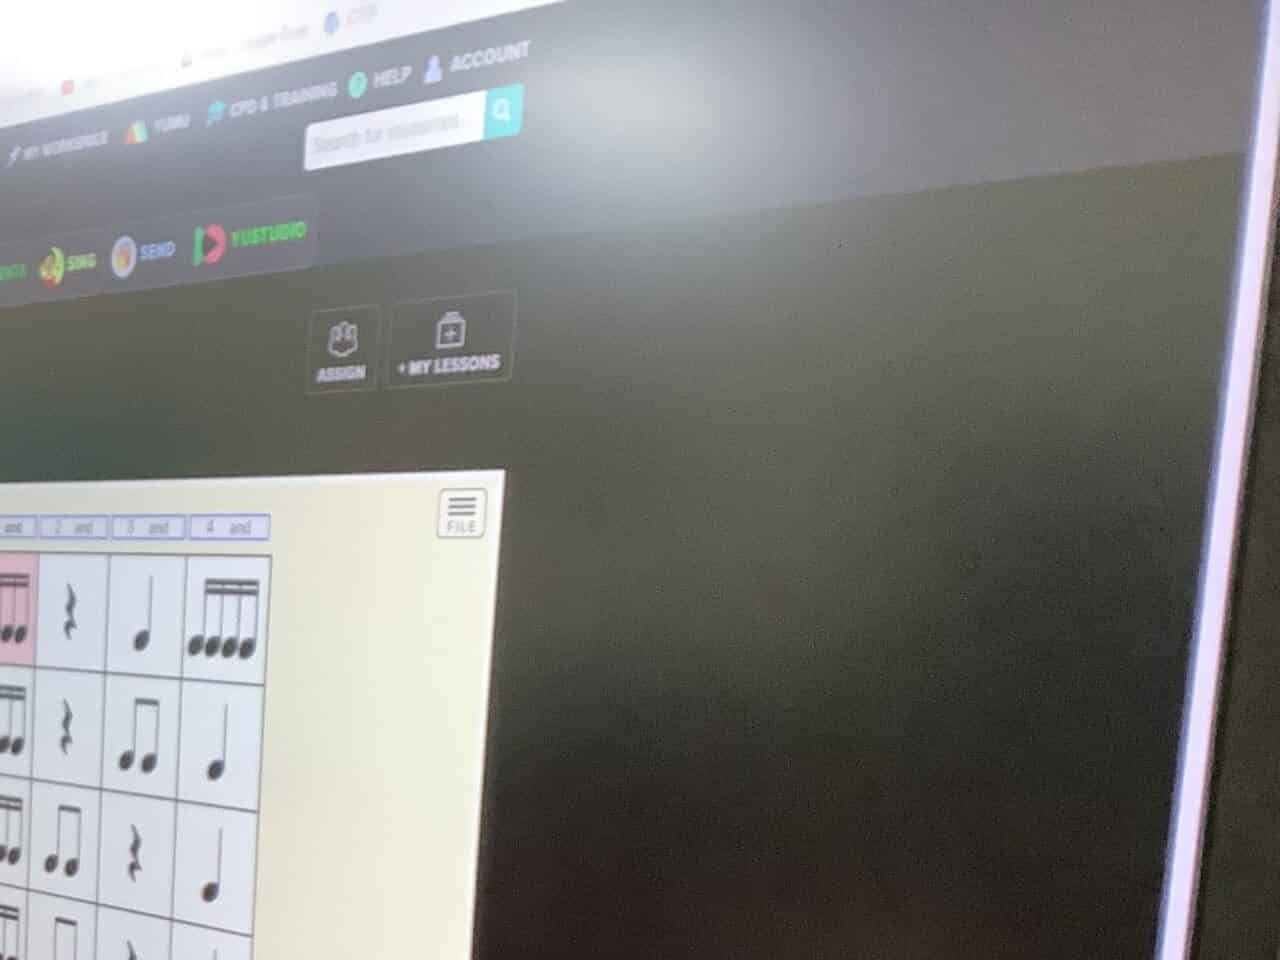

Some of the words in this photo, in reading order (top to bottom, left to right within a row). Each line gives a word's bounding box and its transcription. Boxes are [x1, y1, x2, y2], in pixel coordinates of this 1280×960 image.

[450, 40, 531, 72] ACCOUNT
[374, 66, 414, 88] HELP
[274, 82, 339, 108] TRAINING
[140, 240, 176, 261] SEND
[317, 364, 367, 383] ASSIGN
[408, 358, 432, 375] MY
[434, 353, 501, 373] LESSONS
[448, 520, 477, 534] FILE
